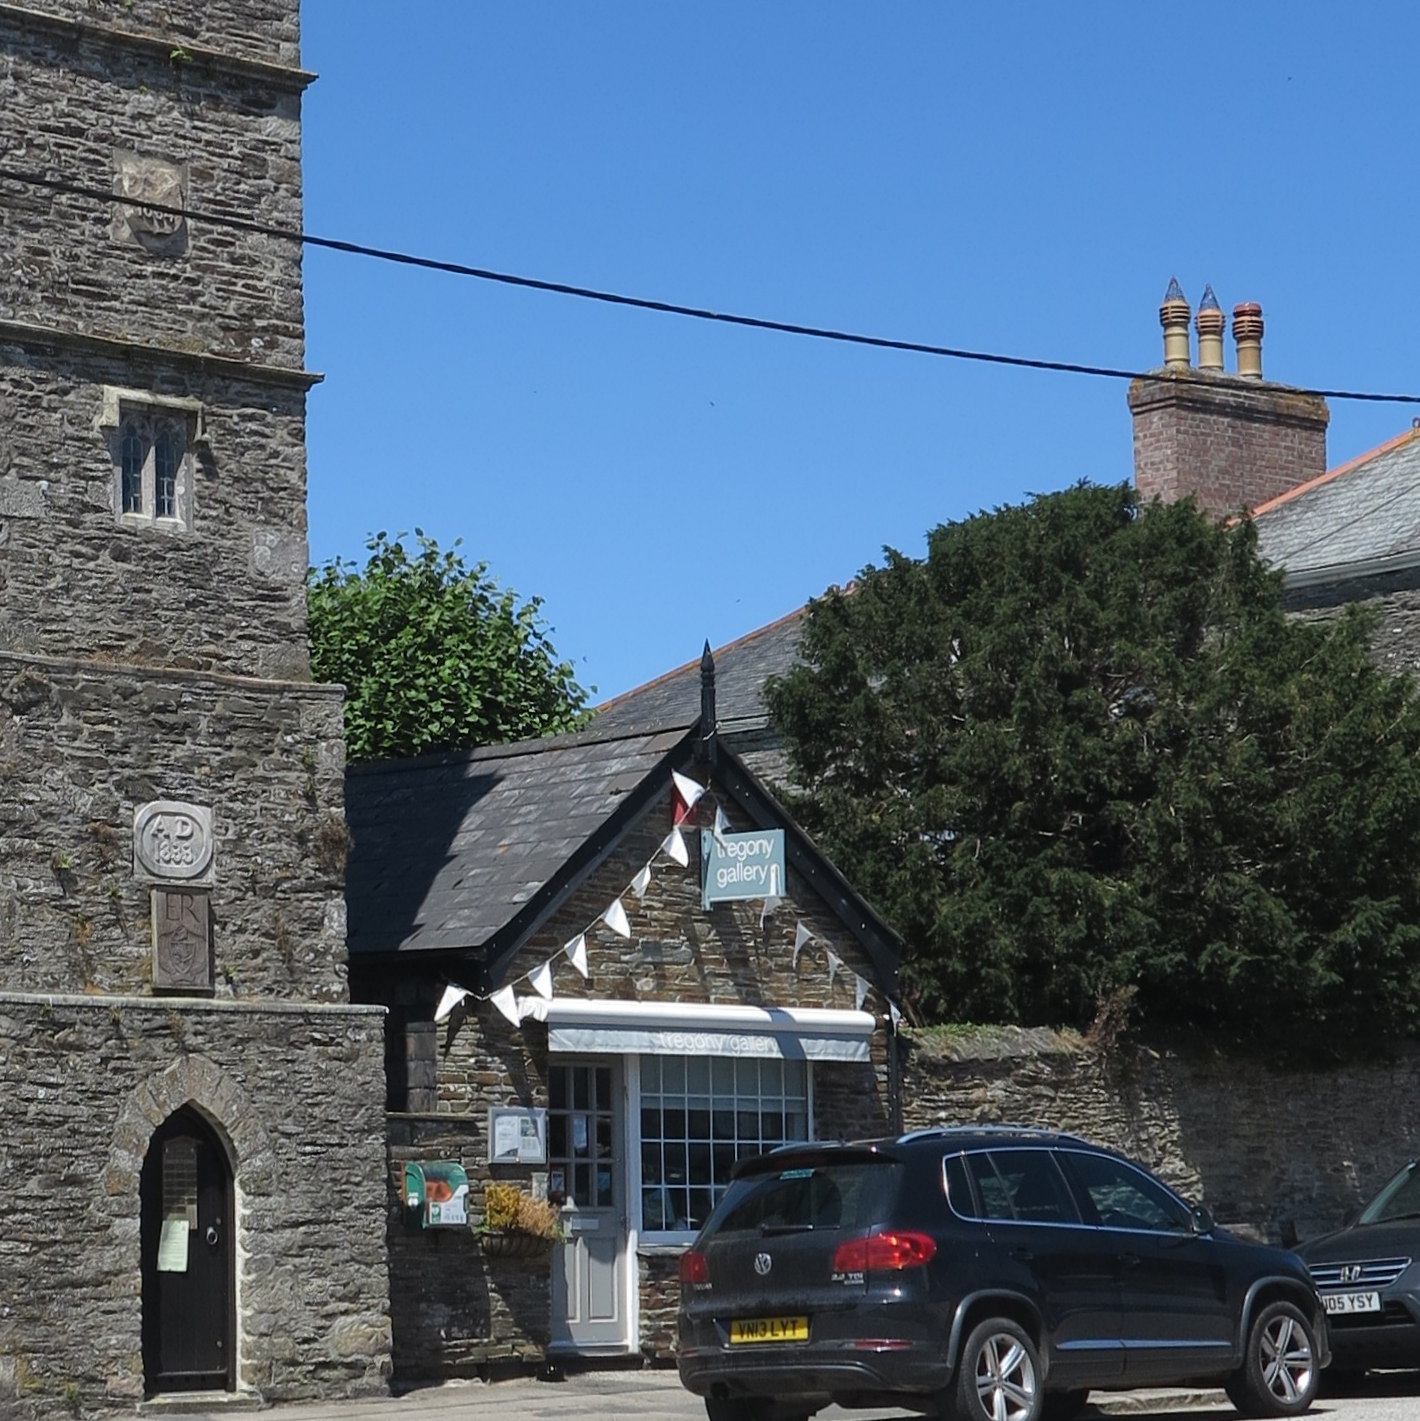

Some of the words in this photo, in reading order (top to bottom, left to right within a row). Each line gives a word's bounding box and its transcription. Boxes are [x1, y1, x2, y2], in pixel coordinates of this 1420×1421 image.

[717, 861, 769, 888] gallery
[165, 892, 200, 923] ER
[1348, 1293, 1374, 1310] YSY
[770, 1319, 799, 1338] LYT
